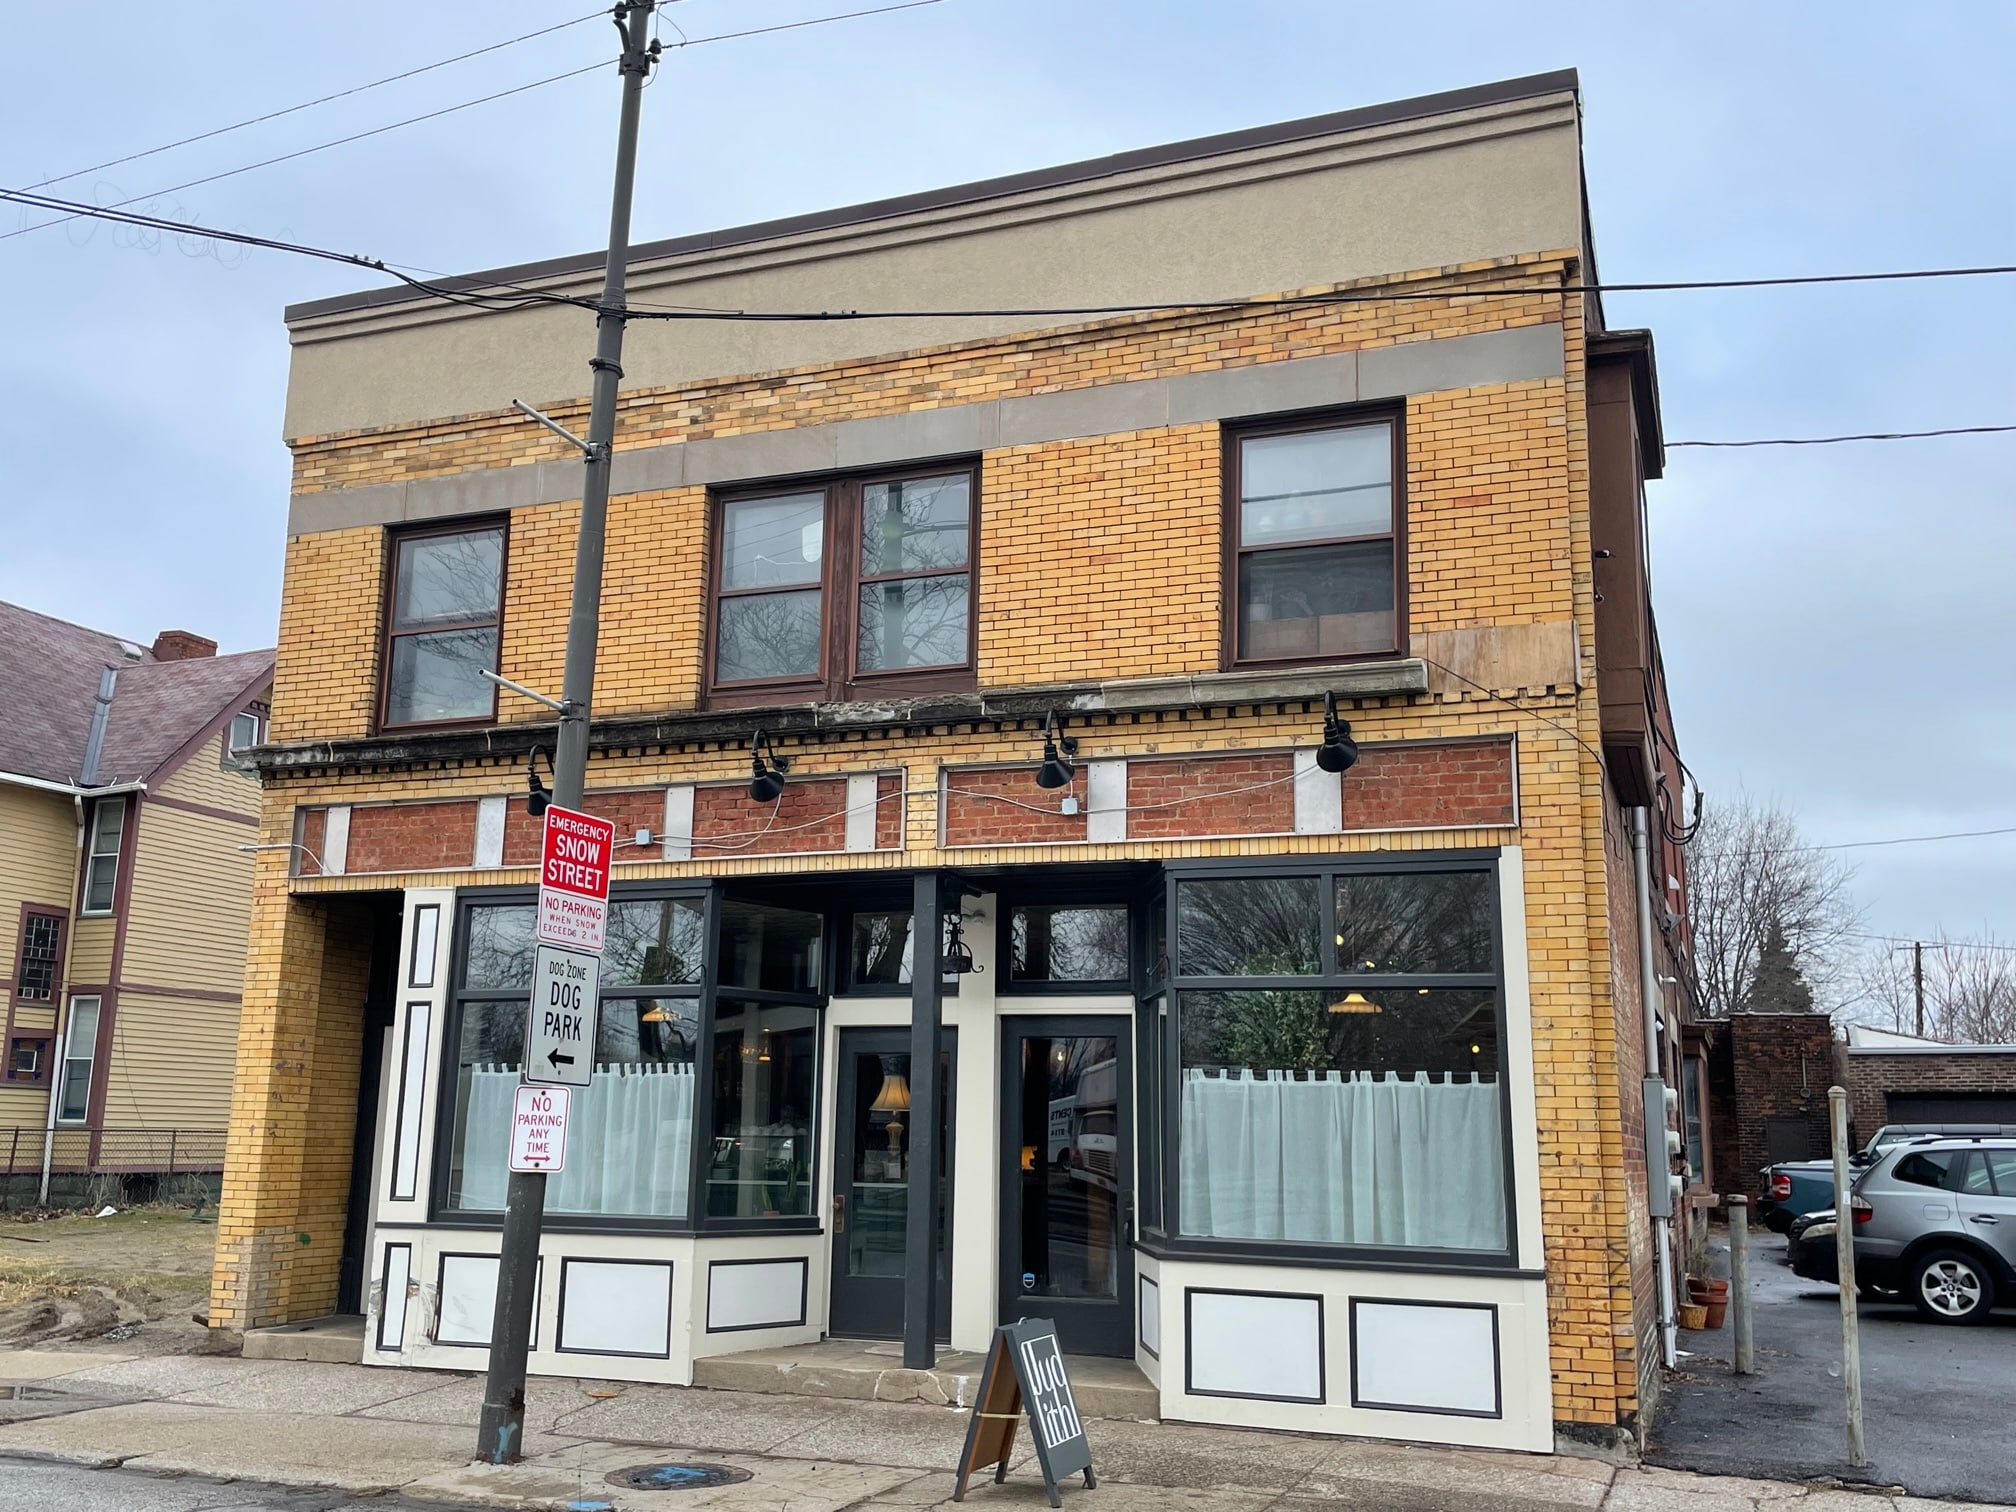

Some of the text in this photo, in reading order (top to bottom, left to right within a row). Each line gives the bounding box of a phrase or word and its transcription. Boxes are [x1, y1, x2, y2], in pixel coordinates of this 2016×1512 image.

[549, 814, 610, 842] EMERGENCY
[556, 834, 600, 865] SNOW
[547, 858, 603, 891] STREET
[545, 896, 602, 920] NO PARKING
[549, 913, 596, 930] WHEN SNOW
[581, 930, 587, 939] 2
[549, 960, 587, 981] DOG ZONE
[550, 981, 581, 1010] DOG
[544, 1011, 582, 1042] PARK
[531, 1096, 552, 1112] NO
[518, 1114, 562, 1127] PARKING
[528, 1128, 550, 1140] ANY
[526, 1141, 550, 1154] TIME
